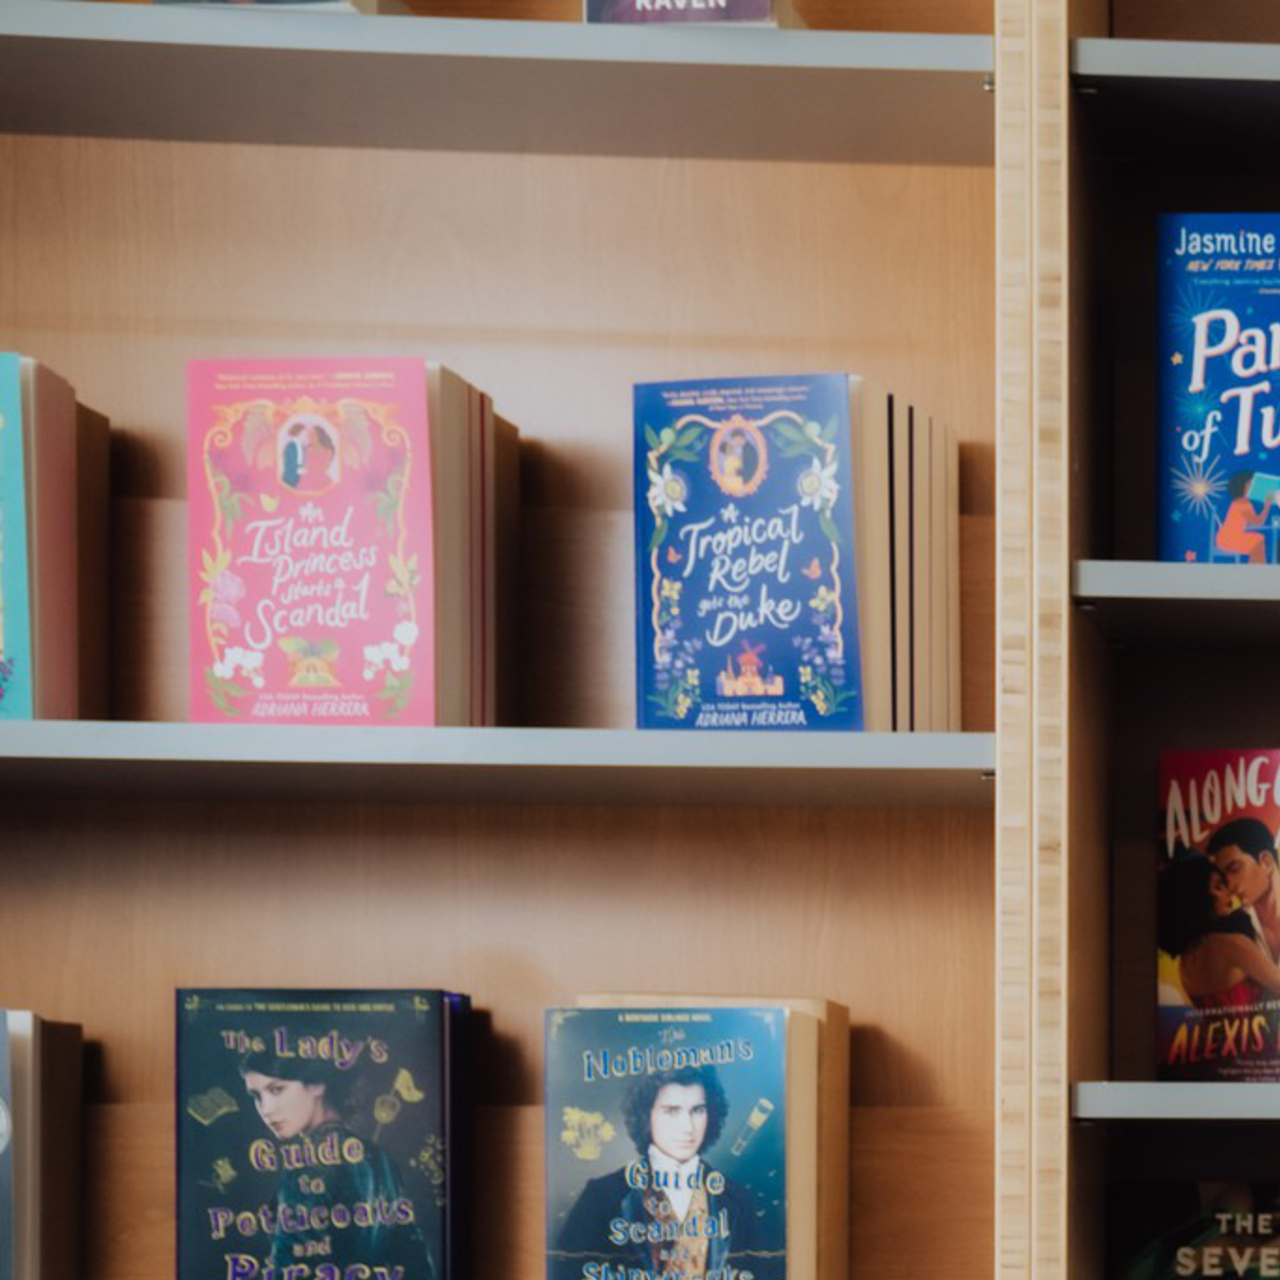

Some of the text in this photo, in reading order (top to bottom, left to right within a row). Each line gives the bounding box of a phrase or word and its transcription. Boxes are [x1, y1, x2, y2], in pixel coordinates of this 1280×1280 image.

[1175, 227, 1276, 256] Jasmine
[1181, 410, 1222, 464] of
[238, 505, 353, 565] Island
[679, 504, 804, 578] Tropical
[271, 545, 378, 594] Princess
[708, 540, 791, 593] Rebel
[245, 572, 370, 649] Scandal
[705, 585, 801, 648] Duke
[1166, 755, 1273, 858] ALONG
[1168, 1014, 1270, 1066] ALEXIS
[248, 1136, 365, 1171] Guide
[625, 1160, 726, 1195] Guide
[208, 1197, 415, 1240] Petticoats
[608, 1208, 730, 1247] Scandal
[1215, 1213, 1273, 1235] THE
